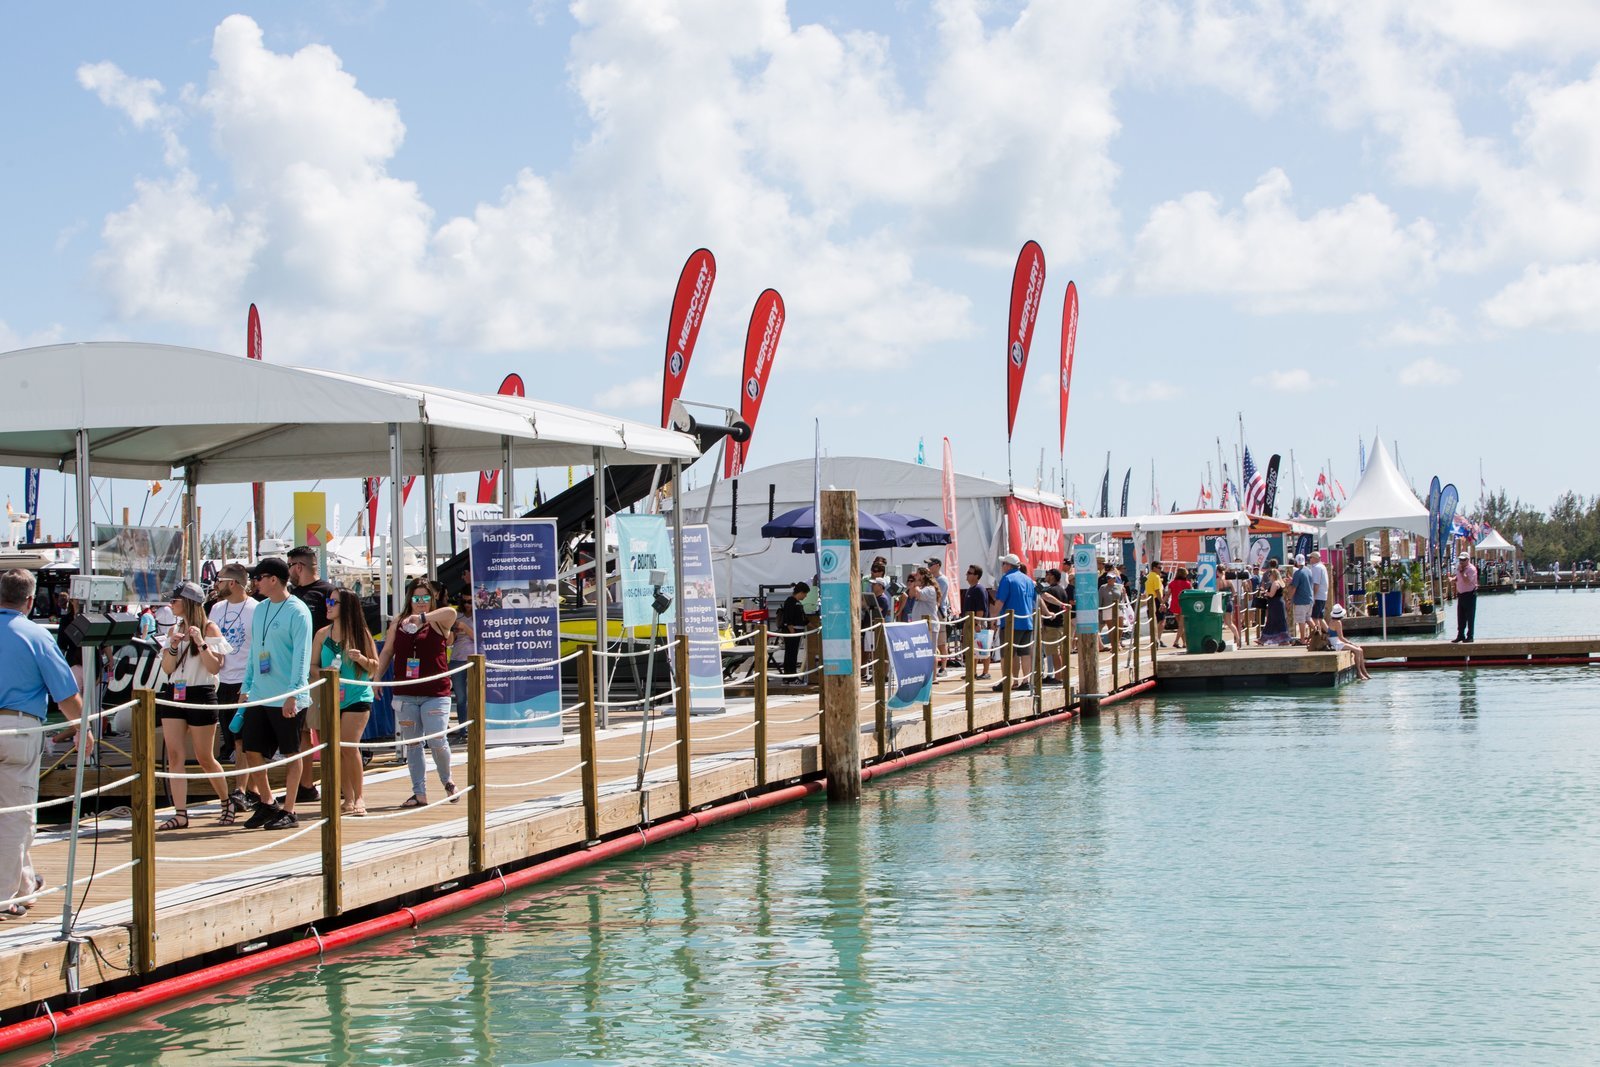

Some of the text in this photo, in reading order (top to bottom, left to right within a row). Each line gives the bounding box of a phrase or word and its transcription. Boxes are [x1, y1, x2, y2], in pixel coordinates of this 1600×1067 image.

[1018, 252, 1040, 343] MERCURY
[678, 258, 709, 352] MERCURY
[754, 299, 780, 379] MERCURY
[482, 532, 534, 543] hands-on
[491, 556, 530, 564] powerboat
[637, 553, 657, 570] BOATING
[1198, 563, 1214, 592] 2
[483, 616, 550, 628] register NOW
[481, 628, 553, 640] and get on the
[482, 640, 552, 651] water TODAY!
